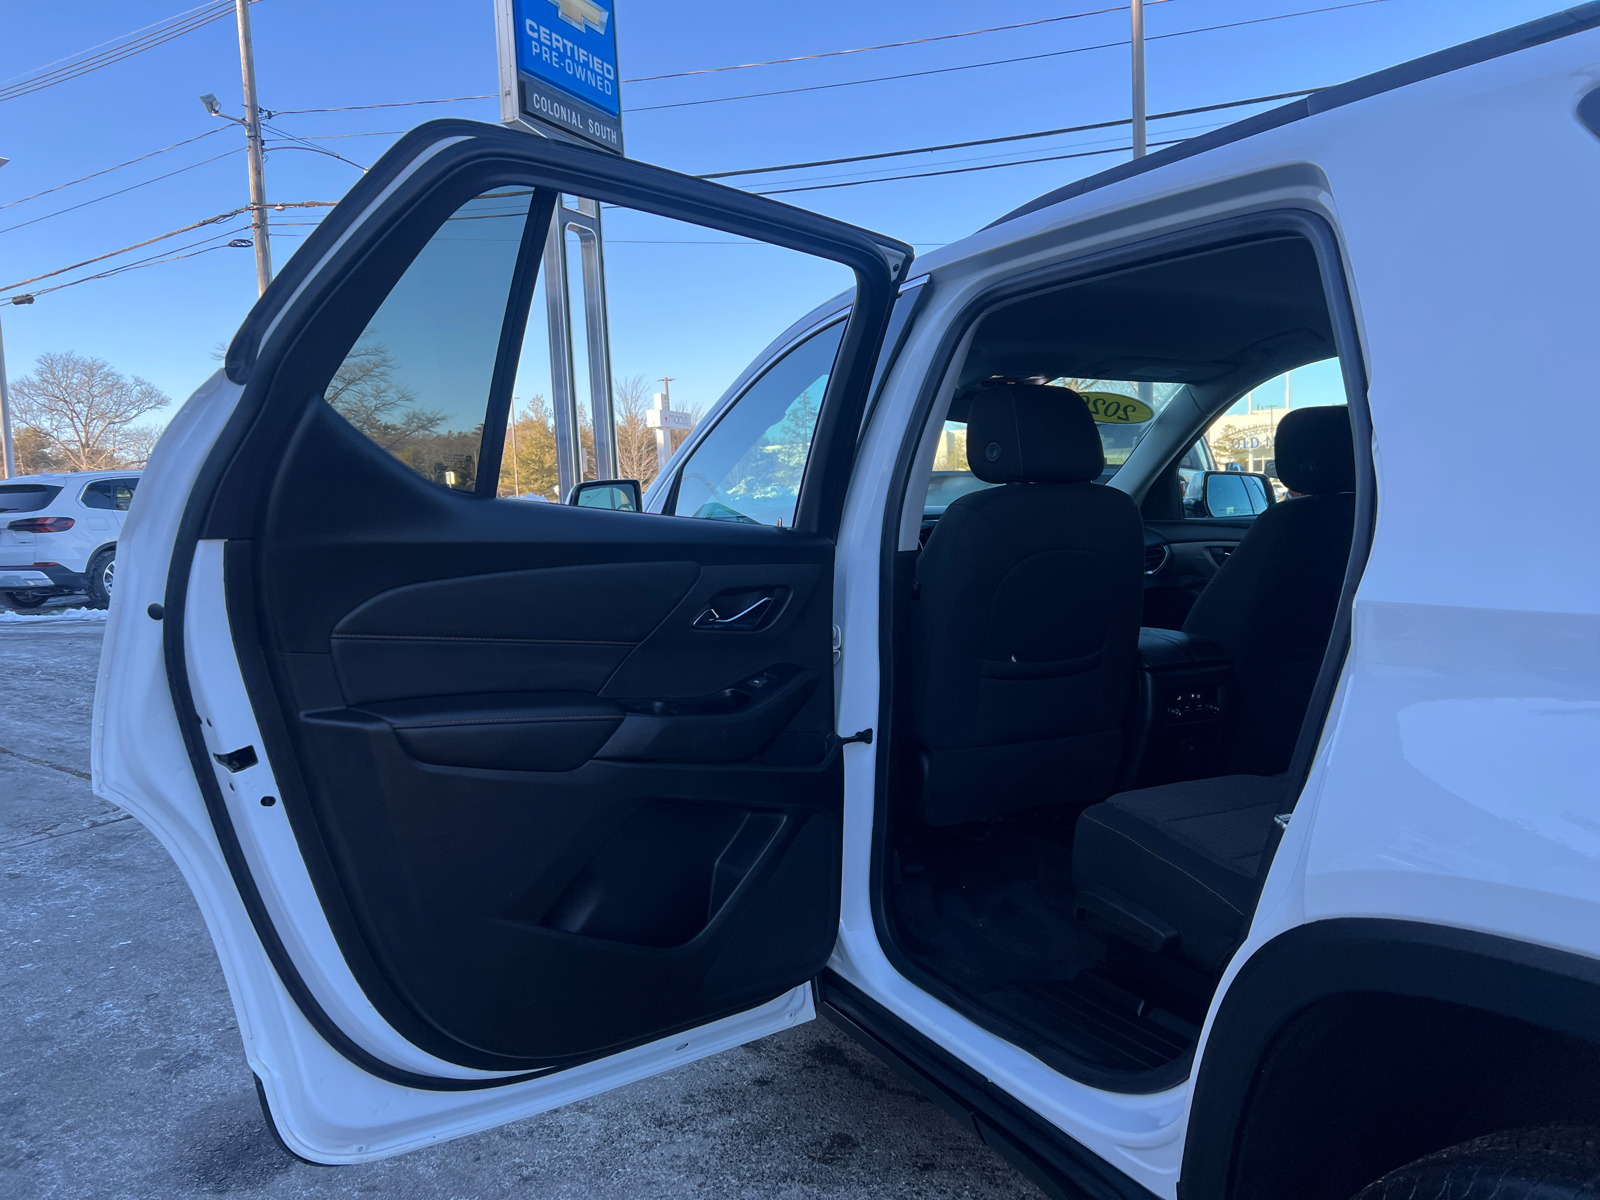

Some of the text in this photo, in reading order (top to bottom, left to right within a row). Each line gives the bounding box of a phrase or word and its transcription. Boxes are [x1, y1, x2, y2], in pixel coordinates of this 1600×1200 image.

[525, 19, 614, 80] CERTIFIED
[531, 40, 612, 95] PRE-OWNED
[533, 93, 617, 144] COLONIAL SOUTH
[1231, 436, 1260, 450] OLD
